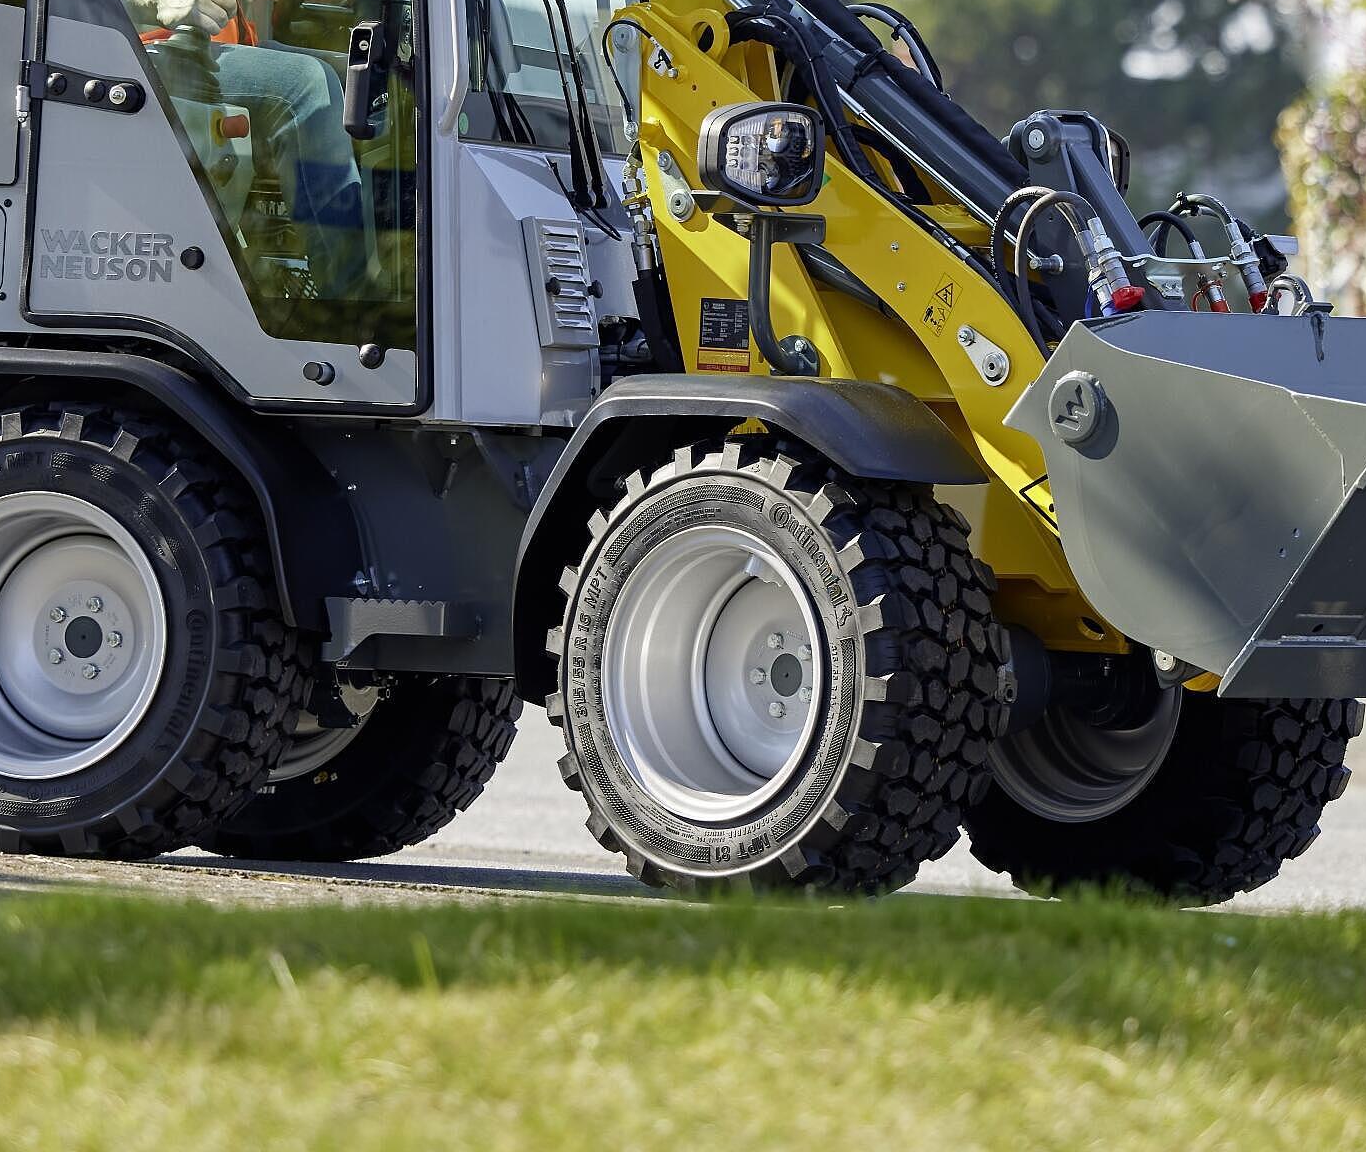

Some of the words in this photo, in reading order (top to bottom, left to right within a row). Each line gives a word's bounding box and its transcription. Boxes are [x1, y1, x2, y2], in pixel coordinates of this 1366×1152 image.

[40, 228, 175, 257] WACKER
[40, 254, 173, 283] NEUSON
[769, 502, 849, 608] Continental
[584, 565, 608, 610] MPT
[578, 613, 592, 632] 16
[574, 636, 587, 651] R
[573, 656, 588, 719] 315/55
[737, 833, 772, 860] MPT
